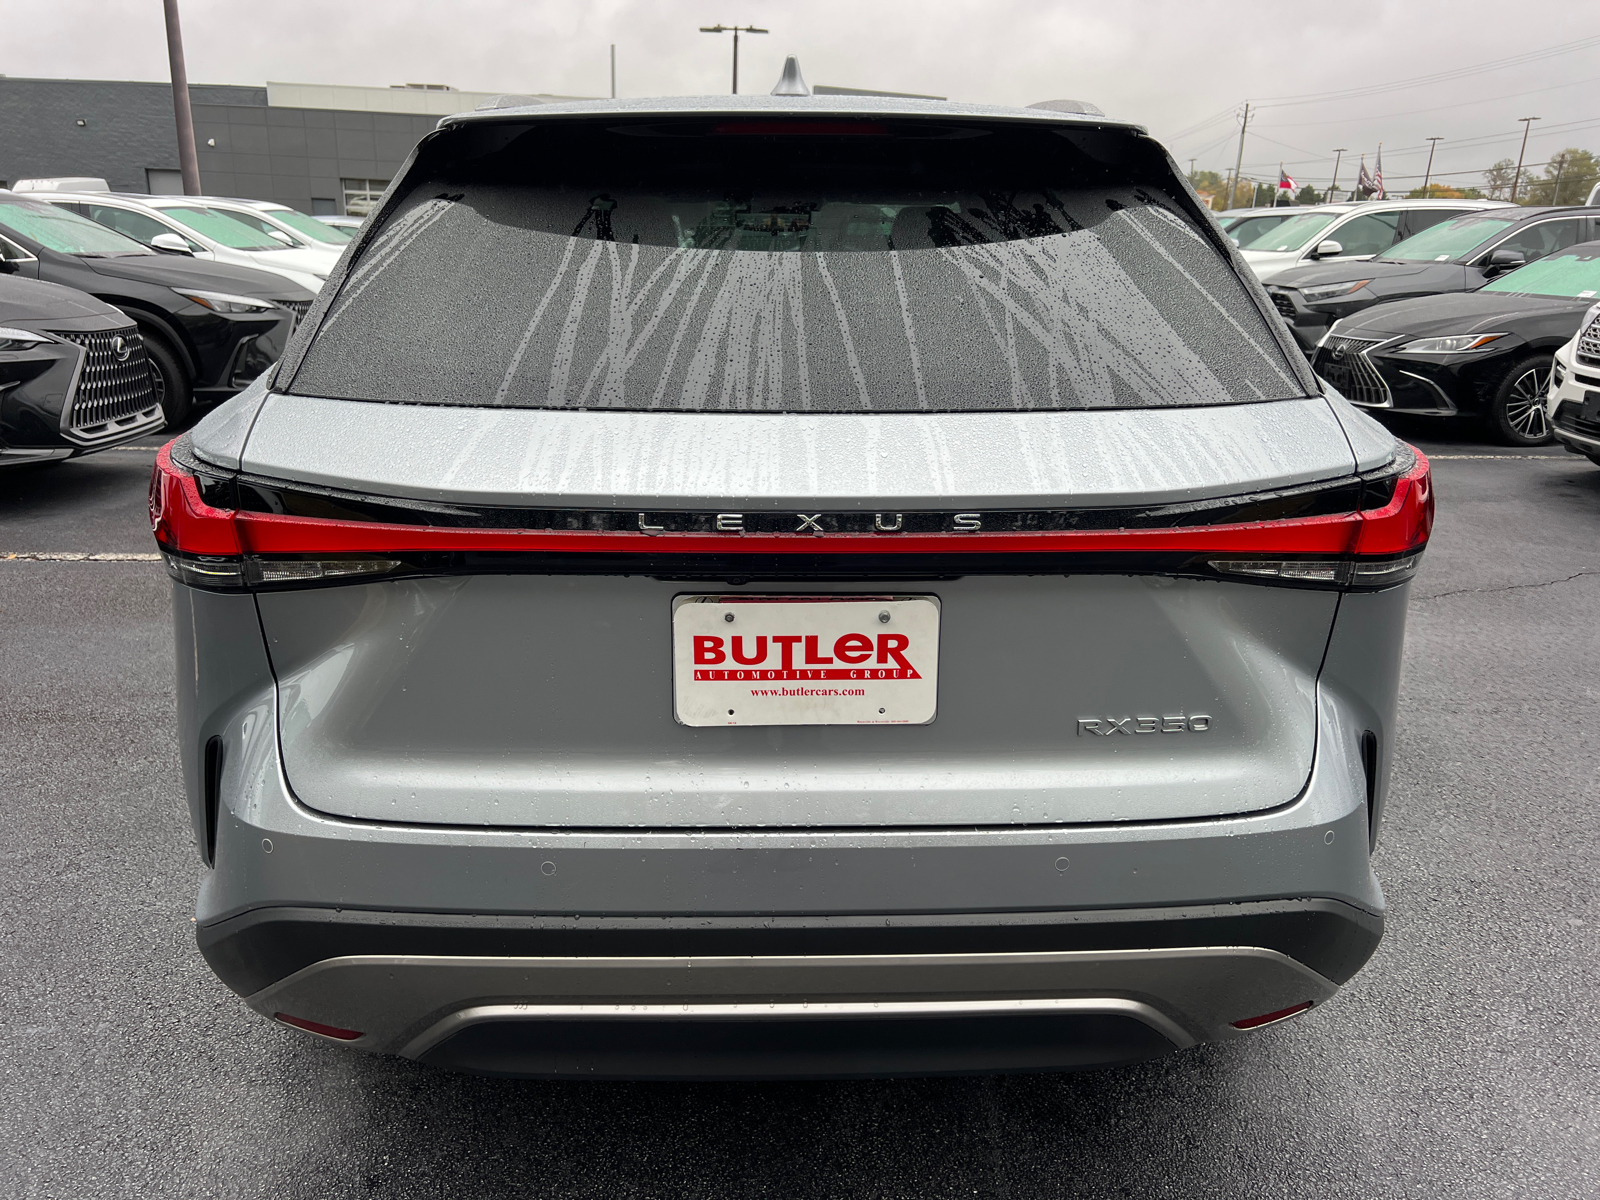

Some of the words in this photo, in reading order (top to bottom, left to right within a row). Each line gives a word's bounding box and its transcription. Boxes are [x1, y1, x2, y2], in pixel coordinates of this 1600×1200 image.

[638, 512, 981, 532] LEXUS
[695, 670, 827, 680] AUTOMOTIVE
[850, 669, 914, 679] GROUP
[750, 687, 865, 697] www.butlercars.com
[1077, 714, 1213, 737] RX350
